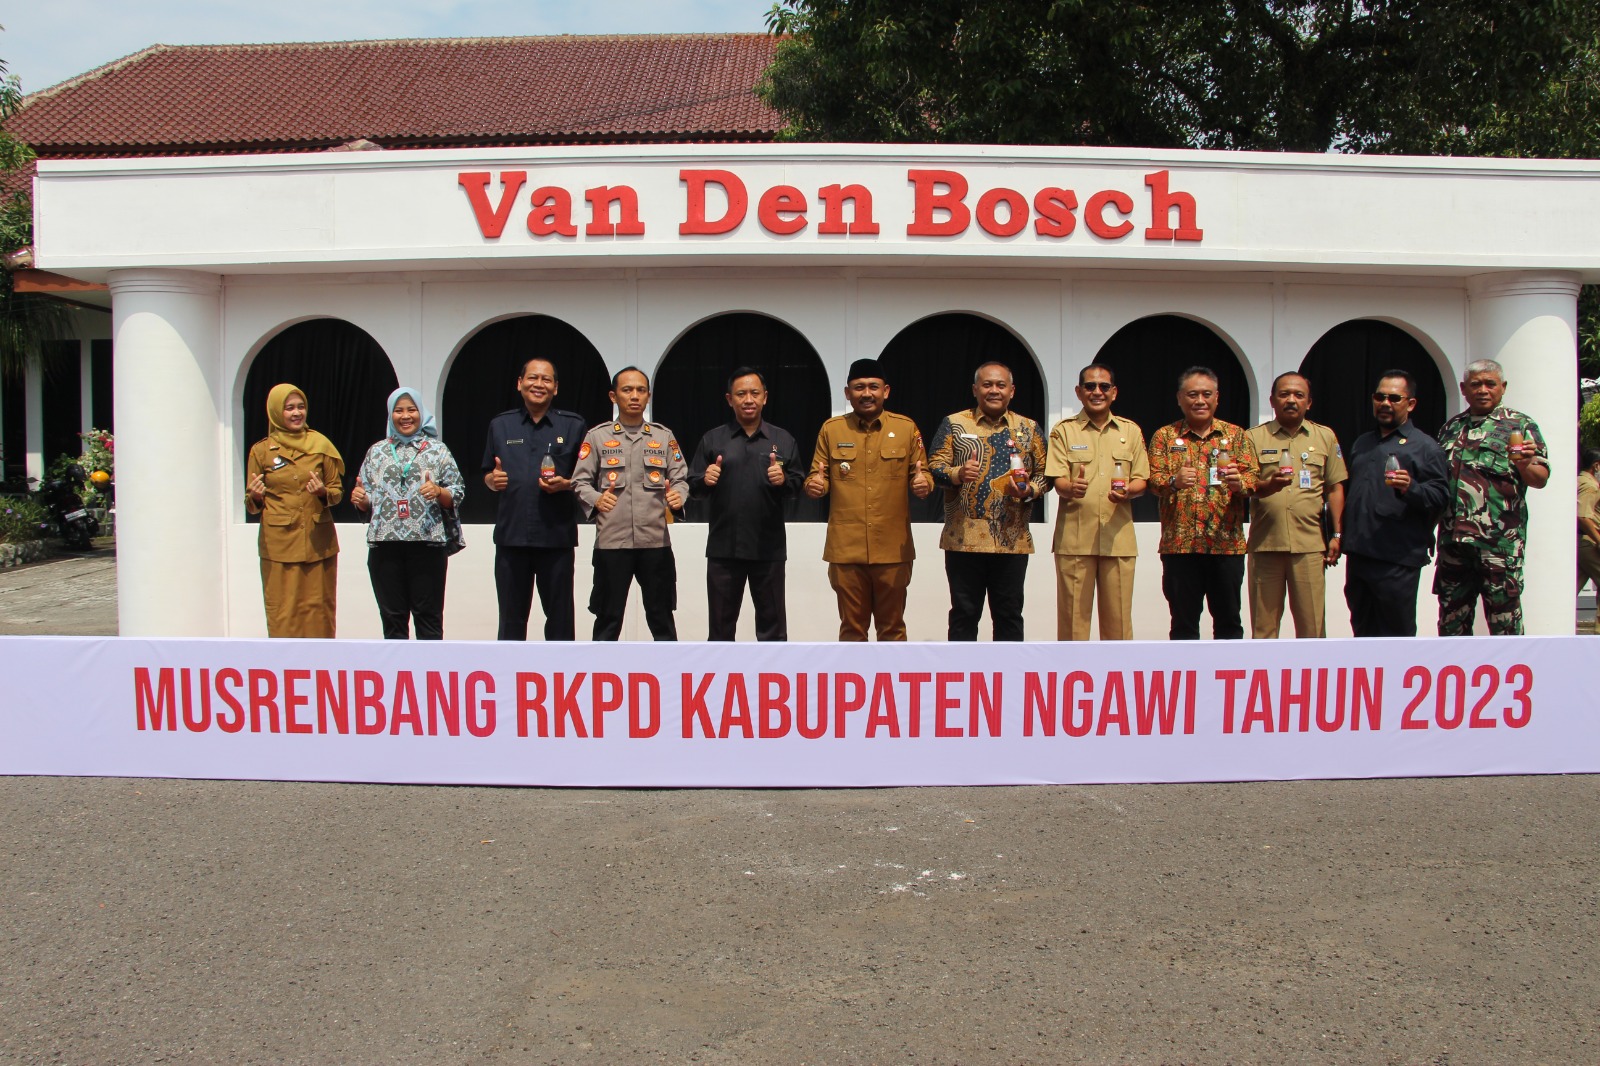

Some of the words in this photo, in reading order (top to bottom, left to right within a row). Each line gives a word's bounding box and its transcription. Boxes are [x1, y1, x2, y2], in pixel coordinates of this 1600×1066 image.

[458, 170, 645, 239] Van
[679, 169, 880, 236] Den
[907, 169, 1203, 241] Bosch
[135, 666, 497, 738] MUSRENBANG
[516, 671, 661, 739] RKPD
[682, 671, 1003, 740] KABUPATEN
[1024, 669, 1197, 738] NGAWI
[1216, 666, 1384, 734] TAHUN
[1402, 663, 1533, 731] 2023
